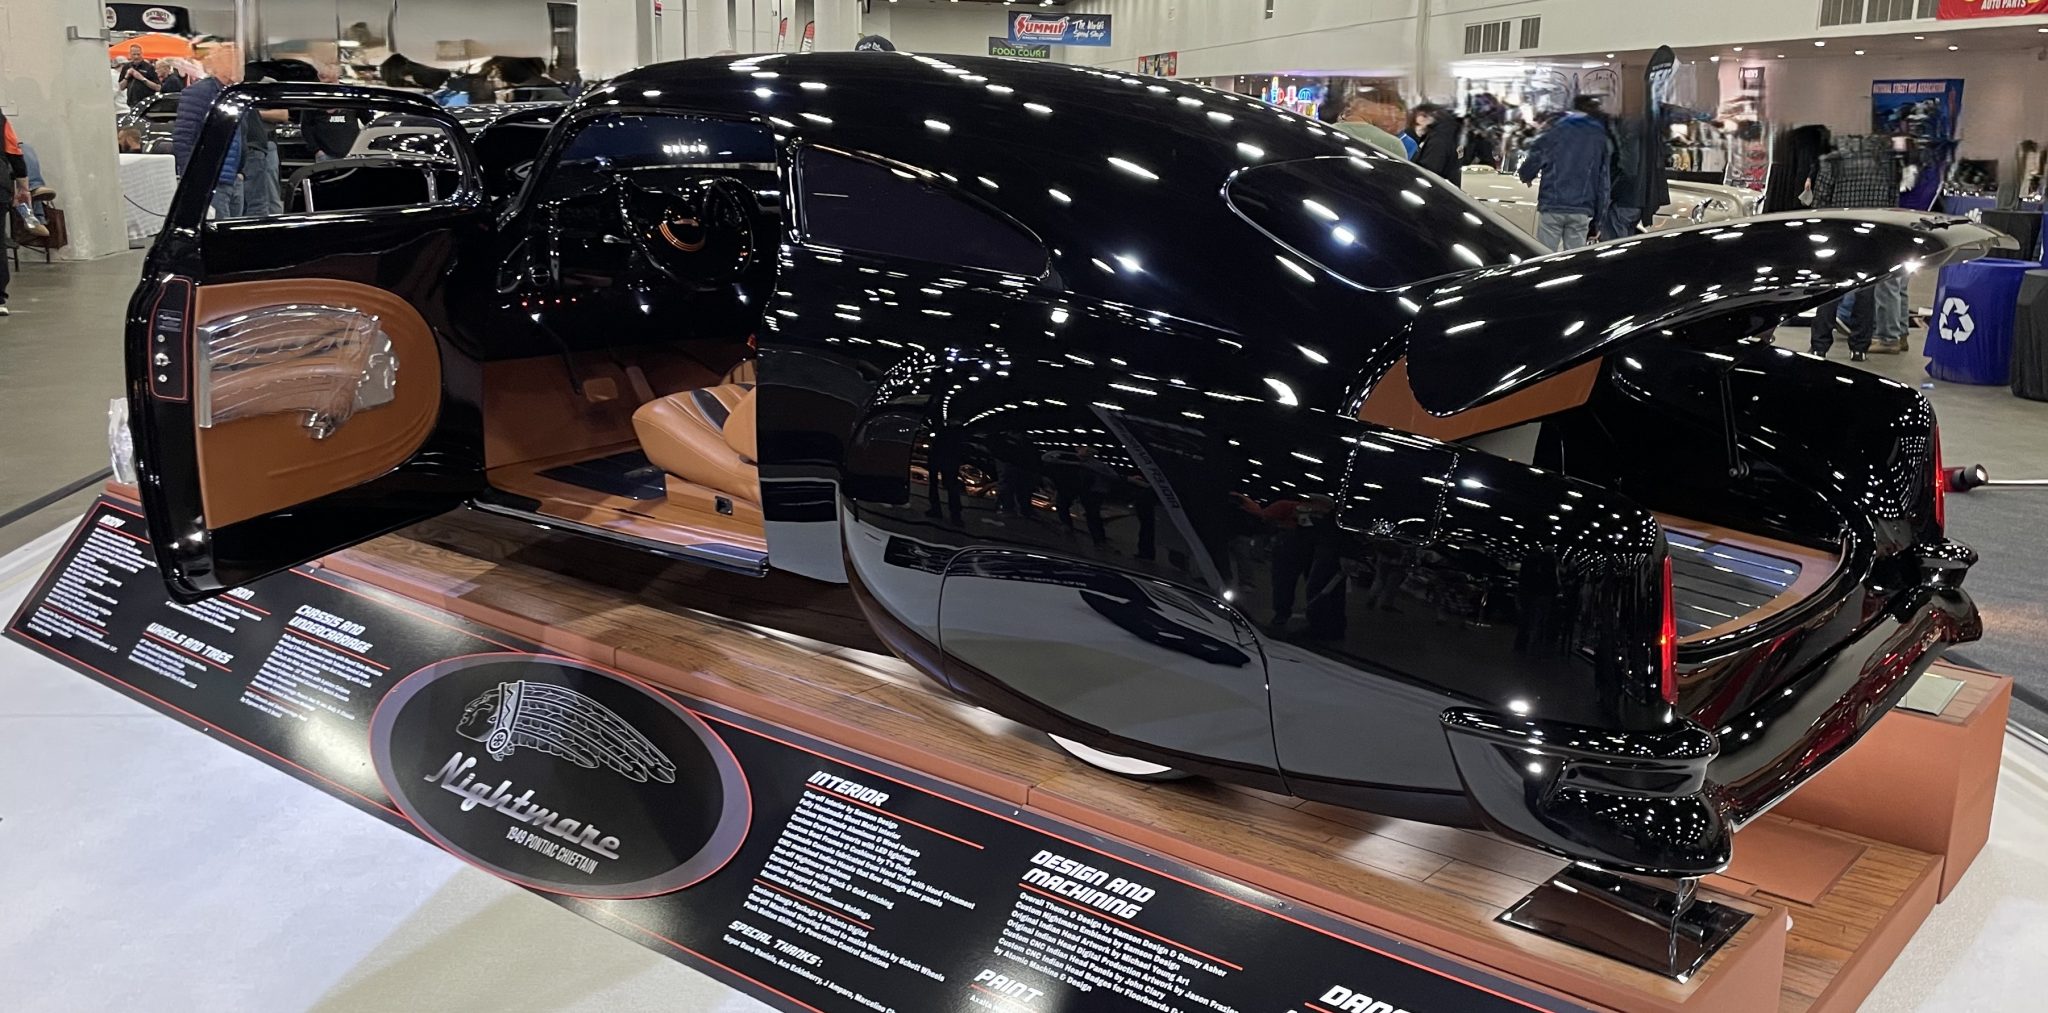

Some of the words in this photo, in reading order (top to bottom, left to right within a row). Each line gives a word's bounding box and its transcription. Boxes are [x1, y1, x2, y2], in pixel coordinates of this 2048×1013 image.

[1016, 15, 1067, 39] SUMMIT
[1981, 0, 2001, 10] AUTO
[2002, 0, 2026, 9] PARTS
[992, 47, 1016, 56] FOOD
[1018, 48, 1047, 58] COURT
[146, 622, 187, 644] WHEELS
[181, 637, 205, 652] AND
[202, 645, 234, 664] TIRES
[288, 616, 374, 654] UNDERCARRIAGE
[295, 604, 345, 628] CHASSIS
[338, 621, 366, 636] AND
[423, 751, 621, 861] Nightmare
[808, 770, 890, 807] INTERIOR
[505, 826, 527, 845] 1949
[524, 834, 560, 856] PONTIAC
[556, 847, 599, 875] CHIEFTAIN
[1021, 868, 1143, 919] MACHINING
[1030, 850, 1110, 886] DESIGN
[1104, 877, 1156, 903] AND
[728, 920, 773, 945] SPECIAL
[773, 938, 824, 967] THANKS:
[1011, 910, 1039, 925] Original
[1038, 920, 1061, 934] Indian
[1060, 929, 1081, 942] Head
[1080, 937, 1111, 954] Artwork
[1110, 948, 1121, 959] by
[1120, 953, 1152, 970] Michael
[1152, 965, 1176, 981] Young
[1175, 975, 1190, 986] Art
[1015, 900, 1042, 916] Custom
[1041, 911, 1079, 930] Nightmare
[1078, 925, 1112, 944] Emblems
[1112, 938, 1123, 949] by
[1122, 942, 1153, 960] Samson
[1153, 954, 1180, 970] Design
[1019, 891, 1045, 906] Overall
[1045, 901, 1069, 916] Theme
[1076, 913, 1102, 929] Design
[1101, 923, 1112, 933] by
[1112, 927, 1142, 944] Samson
[1142, 939, 1169, 955] Design
[1177, 952, 1202, 968] Danny
[1202, 963, 1227, 977] Asher
[973, 968, 1045, 1002] PAINT
[993, 945, 1004, 956] by
[1002, 950, 1028, 965] Atomic
[1028, 960, 1059, 977] Machine
[1066, 975, 1092, 992] Design
[998, 937, 1025, 953] Custom
[1025, 948, 1042, 959] CNC
[1041, 954, 1064, 968] Indian
[1064, 963, 1085, 977] Head
[1084, 972, 1112, 988] Badges
[1112, 983, 1124, 993] for
[1124, 988, 1169, 1012] Floorboards
[1002, 928, 1029, 943] Custom
[1029, 938, 1046, 950] CNC
[1045, 945, 1068, 959] Indian
[1068, 954, 1089, 967] Head
[1088, 962, 1113, 978] Panels
[1113, 972, 1124, 983] by
[1124, 977, 1144, 990] John
[1144, 985, 1166, 1000] Clary
[1006, 919, 1035, 934] Original
[1034, 929, 1057, 944] Indian
[1056, 938, 1077, 951] Head
[1076, 946, 1101, 961] Digital
[1100, 956, 1141, 978] Production
[1141, 973, 1173, 991] Artwork
[1173, 985, 1185, 996] by
[1184, 990, 1209, 1005] Jason
